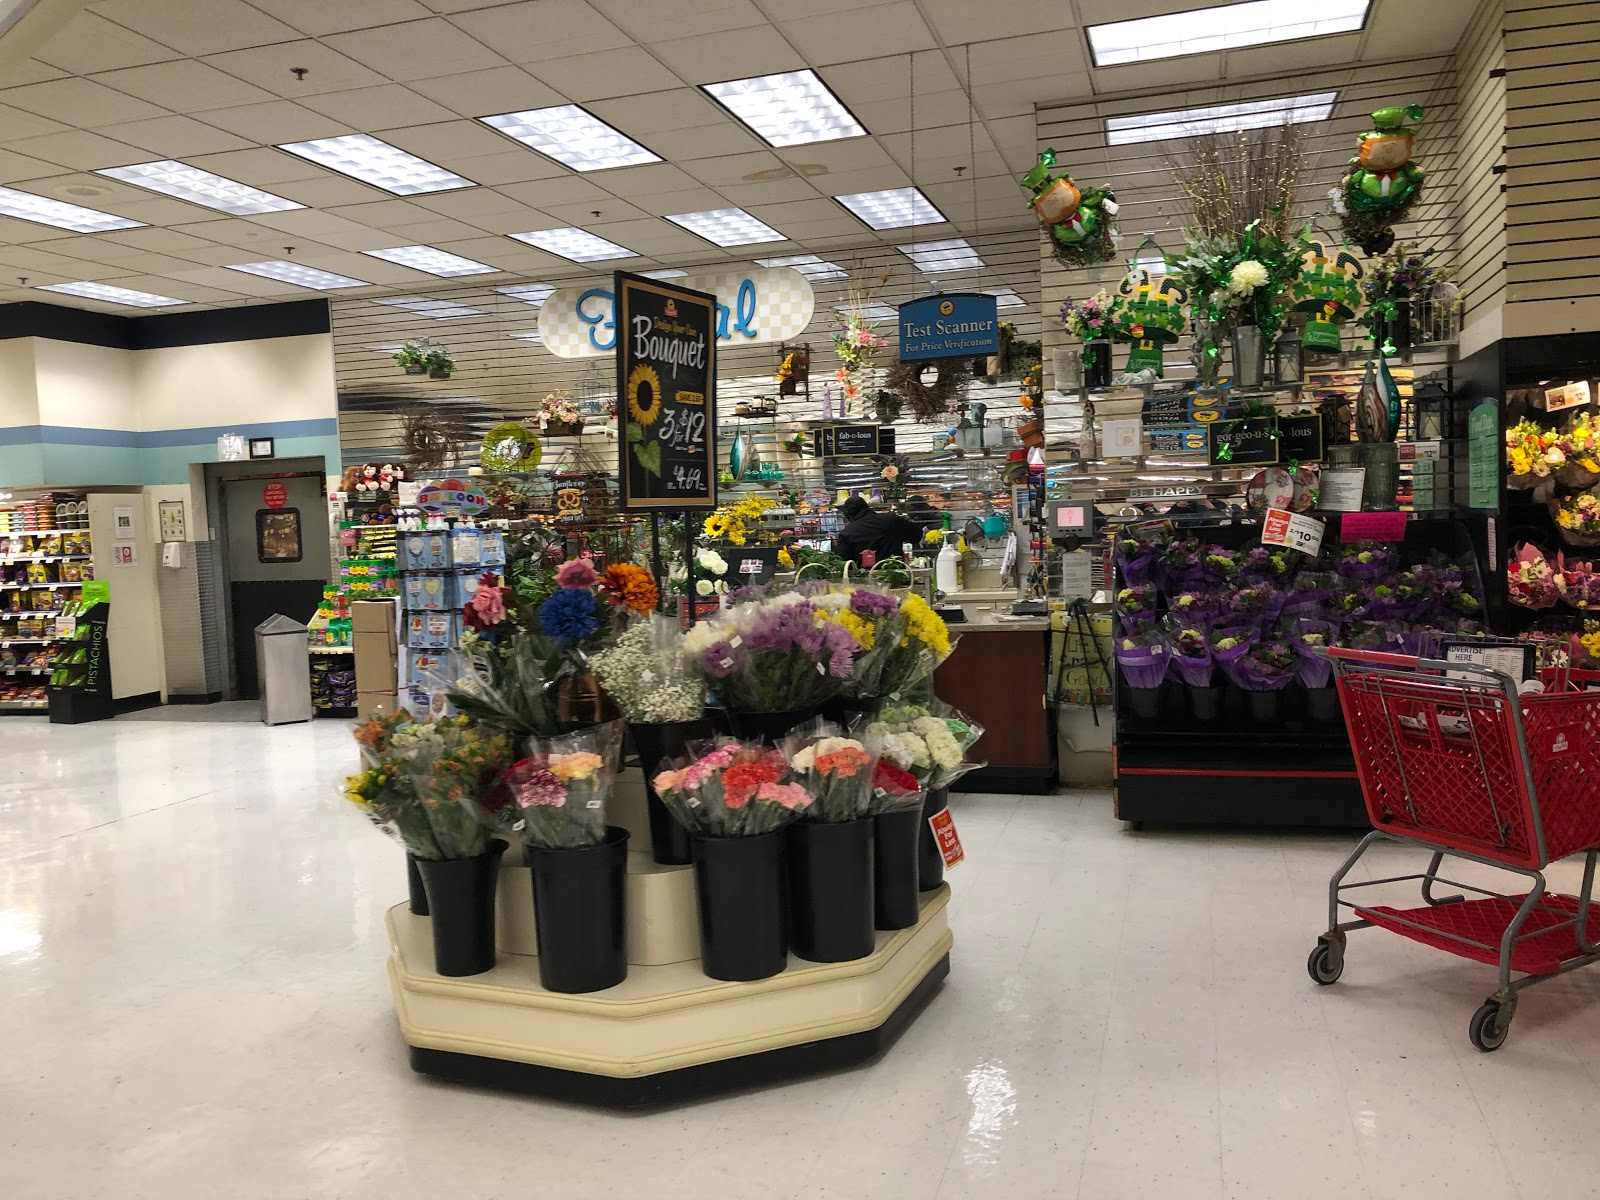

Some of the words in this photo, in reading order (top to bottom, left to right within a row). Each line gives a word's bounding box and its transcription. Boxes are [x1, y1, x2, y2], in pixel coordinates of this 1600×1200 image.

[576, 278, 757, 350] Fal
[903, 322, 932, 338] Test
[936, 319, 993, 336] Scanner
[632, 314, 705, 380] Bouquet
[905, 343, 919, 353] For
[921, 341, 942, 351] Price
[944, 337, 993, 350] Verification
[658, 407, 676, 440] 3
[419, 491, 485, 506] BALLOON
[1130, 487, 1148, 498] BE
[1153, 485, 1205, 497] HAPPY
[87, 625, 103, 685] PISTACHIOS
[1455, 653, 1472, 661] HERE
